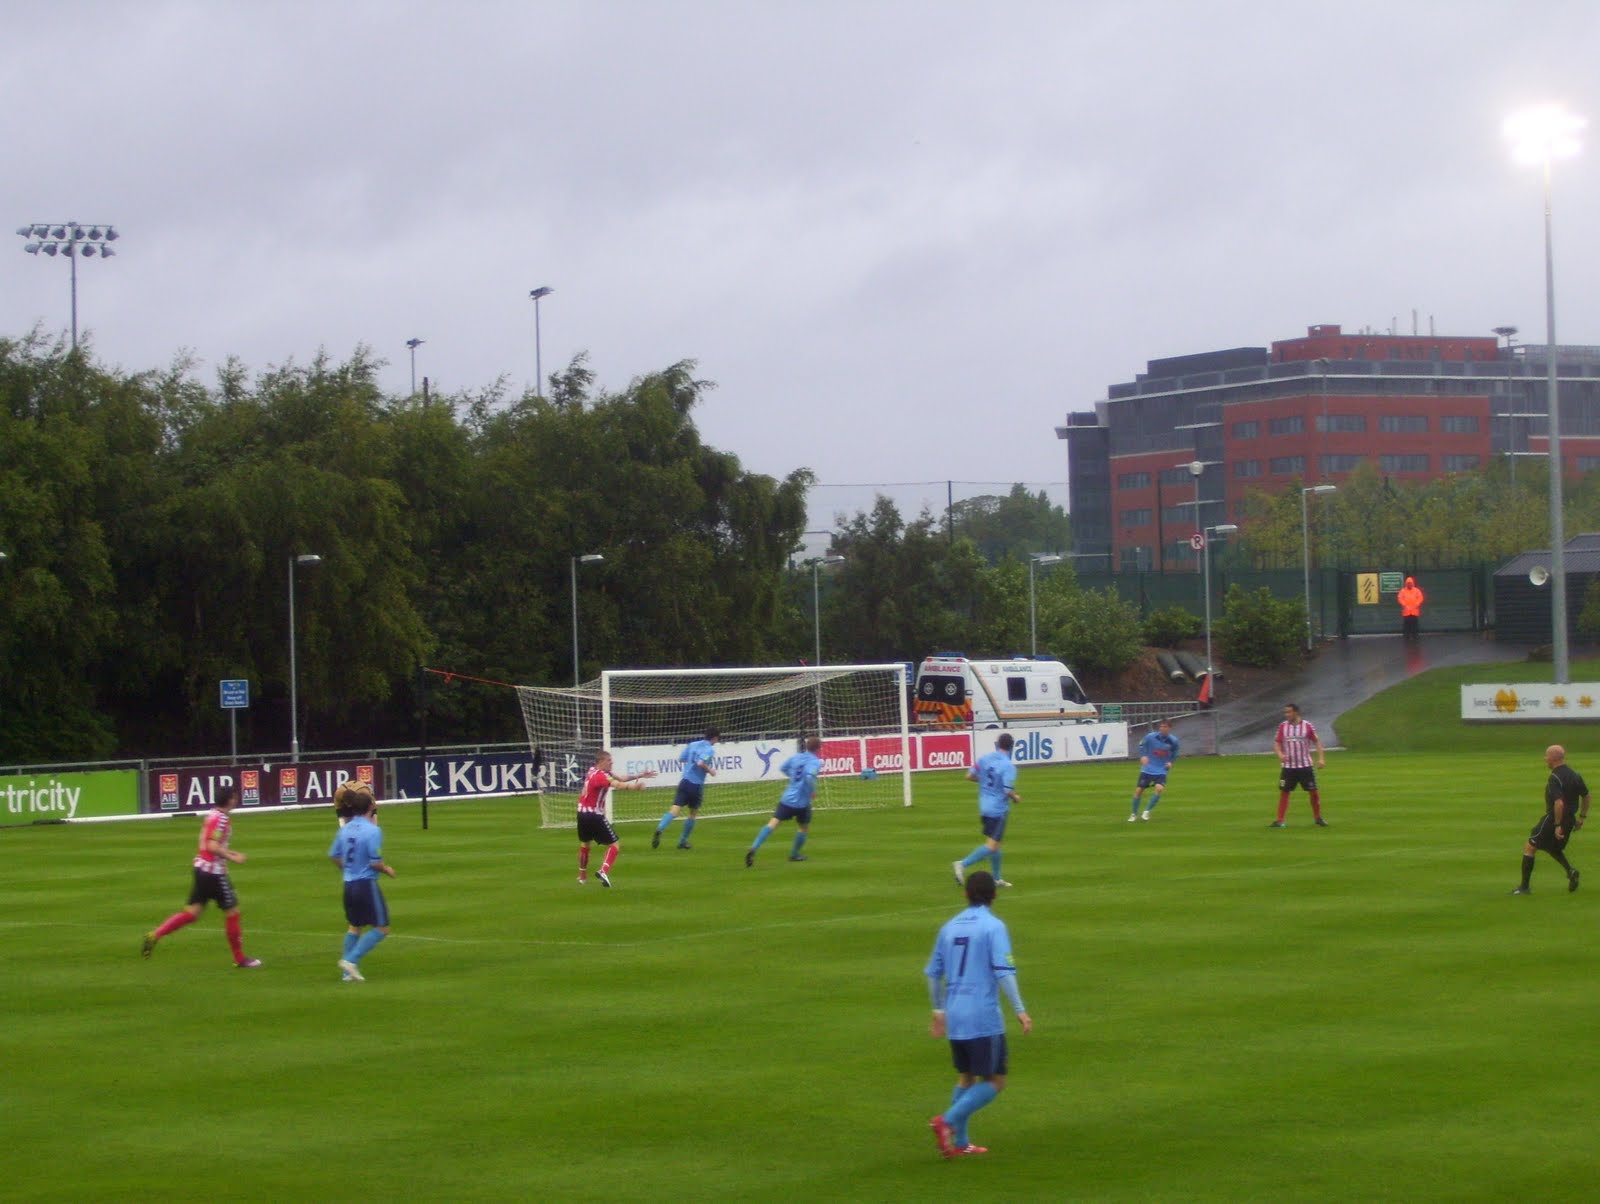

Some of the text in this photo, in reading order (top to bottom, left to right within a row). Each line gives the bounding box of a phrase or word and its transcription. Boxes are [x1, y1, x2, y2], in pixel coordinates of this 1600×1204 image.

[994, 732, 1054, 762] alls
[626, 760, 654, 775] ECO
[657, 759, 682, 774] WIN
[709, 755, 743, 770] WER
[873, 754, 906, 769] CALO
[929, 752, 965, 768] CALOR
[448, 760, 557, 794] KUKRI
[0, 780, 80, 818] tricity
[162, 793, 177, 802] AIB
[243, 789, 258, 798] AIB
[281, 787, 296, 796] AIB
[954, 936, 970, 977] 7
